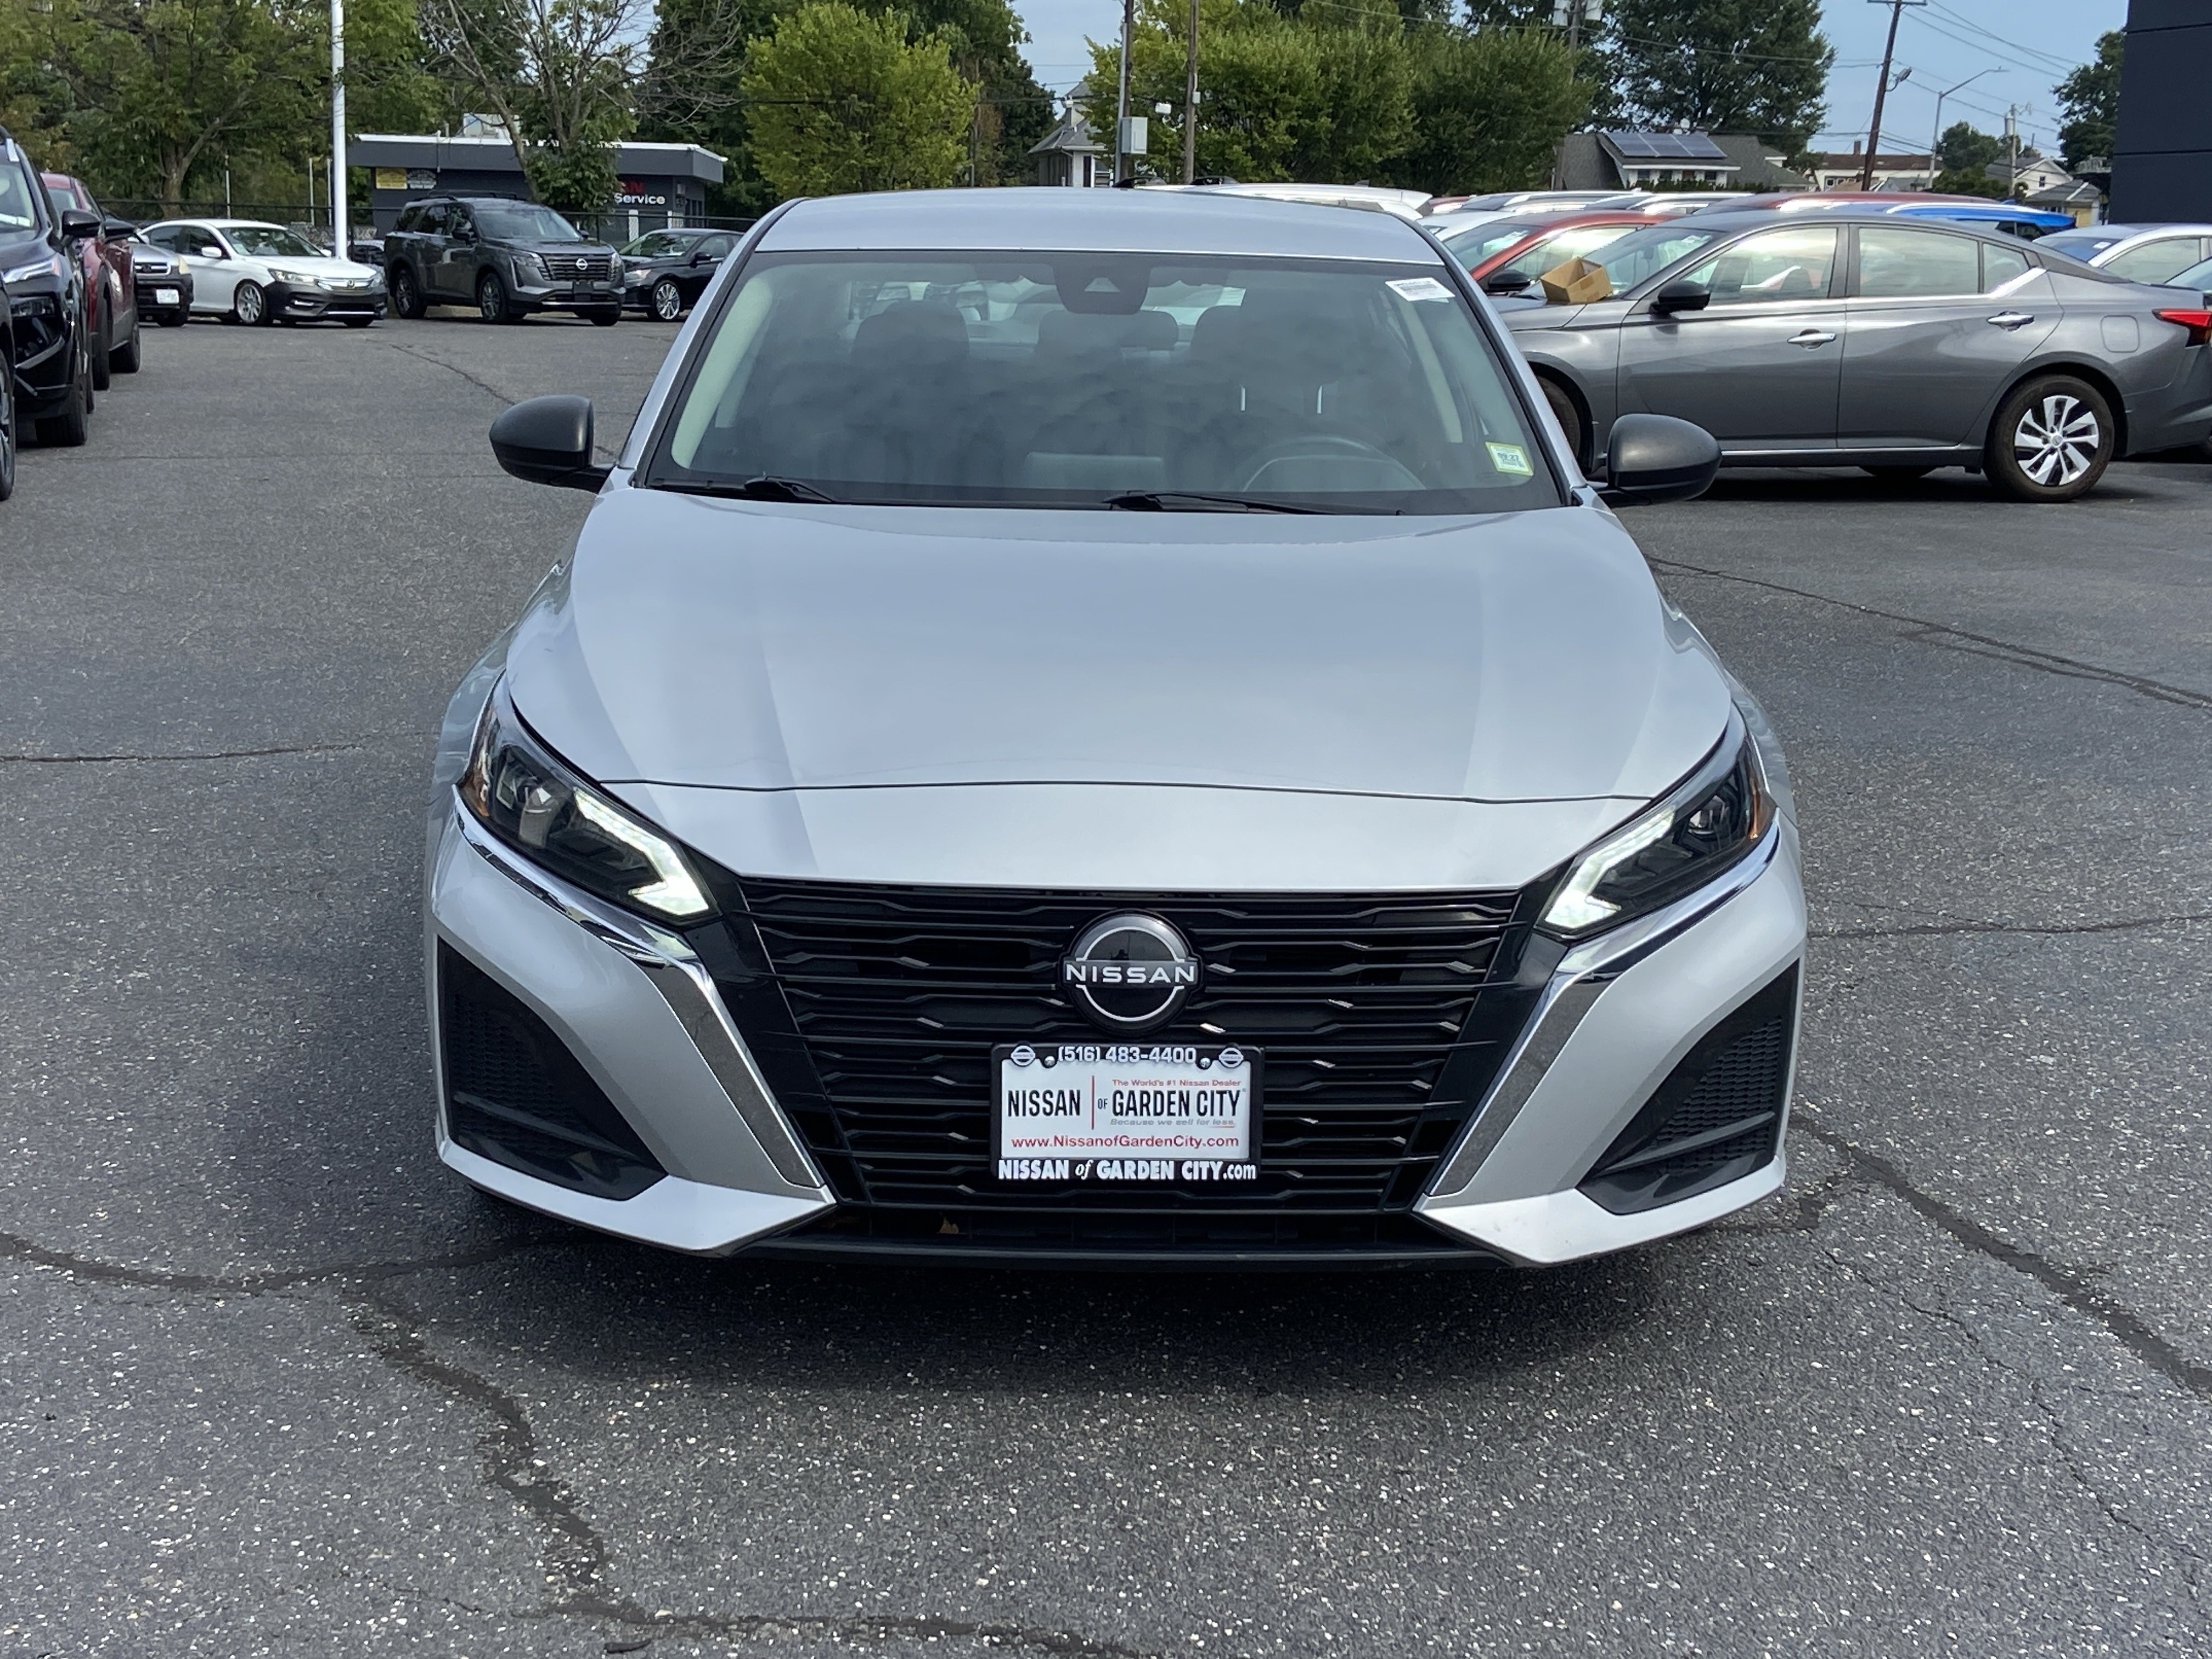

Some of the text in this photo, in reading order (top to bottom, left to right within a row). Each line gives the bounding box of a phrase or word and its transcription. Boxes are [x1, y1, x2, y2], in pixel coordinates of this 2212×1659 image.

[614, 193, 665, 205] Service
[1066, 964, 1195, 984] NISSAN
[1058, 1046, 1197, 1063] (516) 483-4400
[1008, 1090, 1241, 1117] NISSAN OF GARDEN CITY
[1011, 1135, 1239, 1149] www.NissanofGardenCity.com
[998, 1159, 1257, 1180] NISSAN of GARDEN CITY.com
